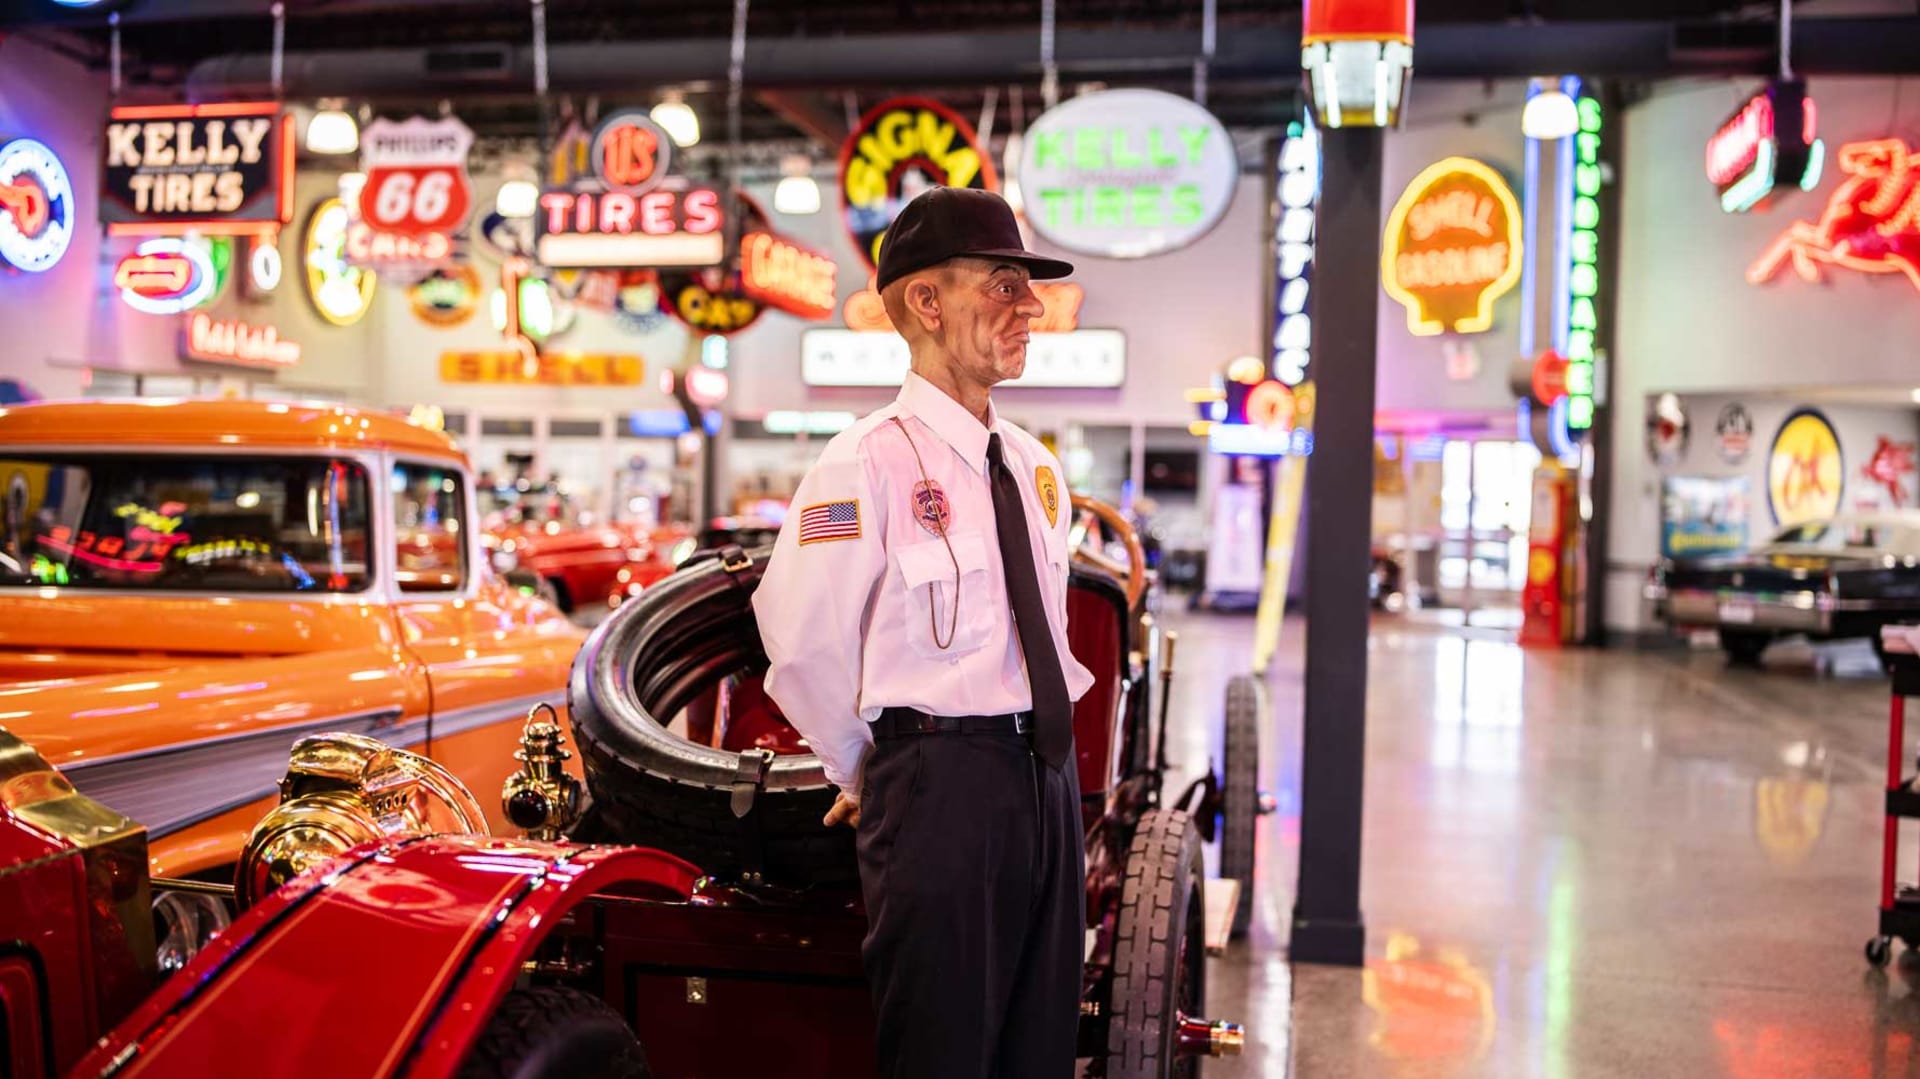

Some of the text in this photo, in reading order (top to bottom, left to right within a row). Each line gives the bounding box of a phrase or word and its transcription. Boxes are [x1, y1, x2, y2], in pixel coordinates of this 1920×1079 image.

[107, 119, 270, 167] KELLY
[375, 134, 457, 152] PHILLIPS
[846, 110, 980, 208] SIGNA
[1034, 124, 1211, 169] KELLY
[129, 172, 244, 212] TIRES
[374, 171, 453, 224] 66
[540, 189, 724, 235] TIRES
[1038, 184, 1203, 227] TIRES
[1407, 190, 1495, 241] SHELL
